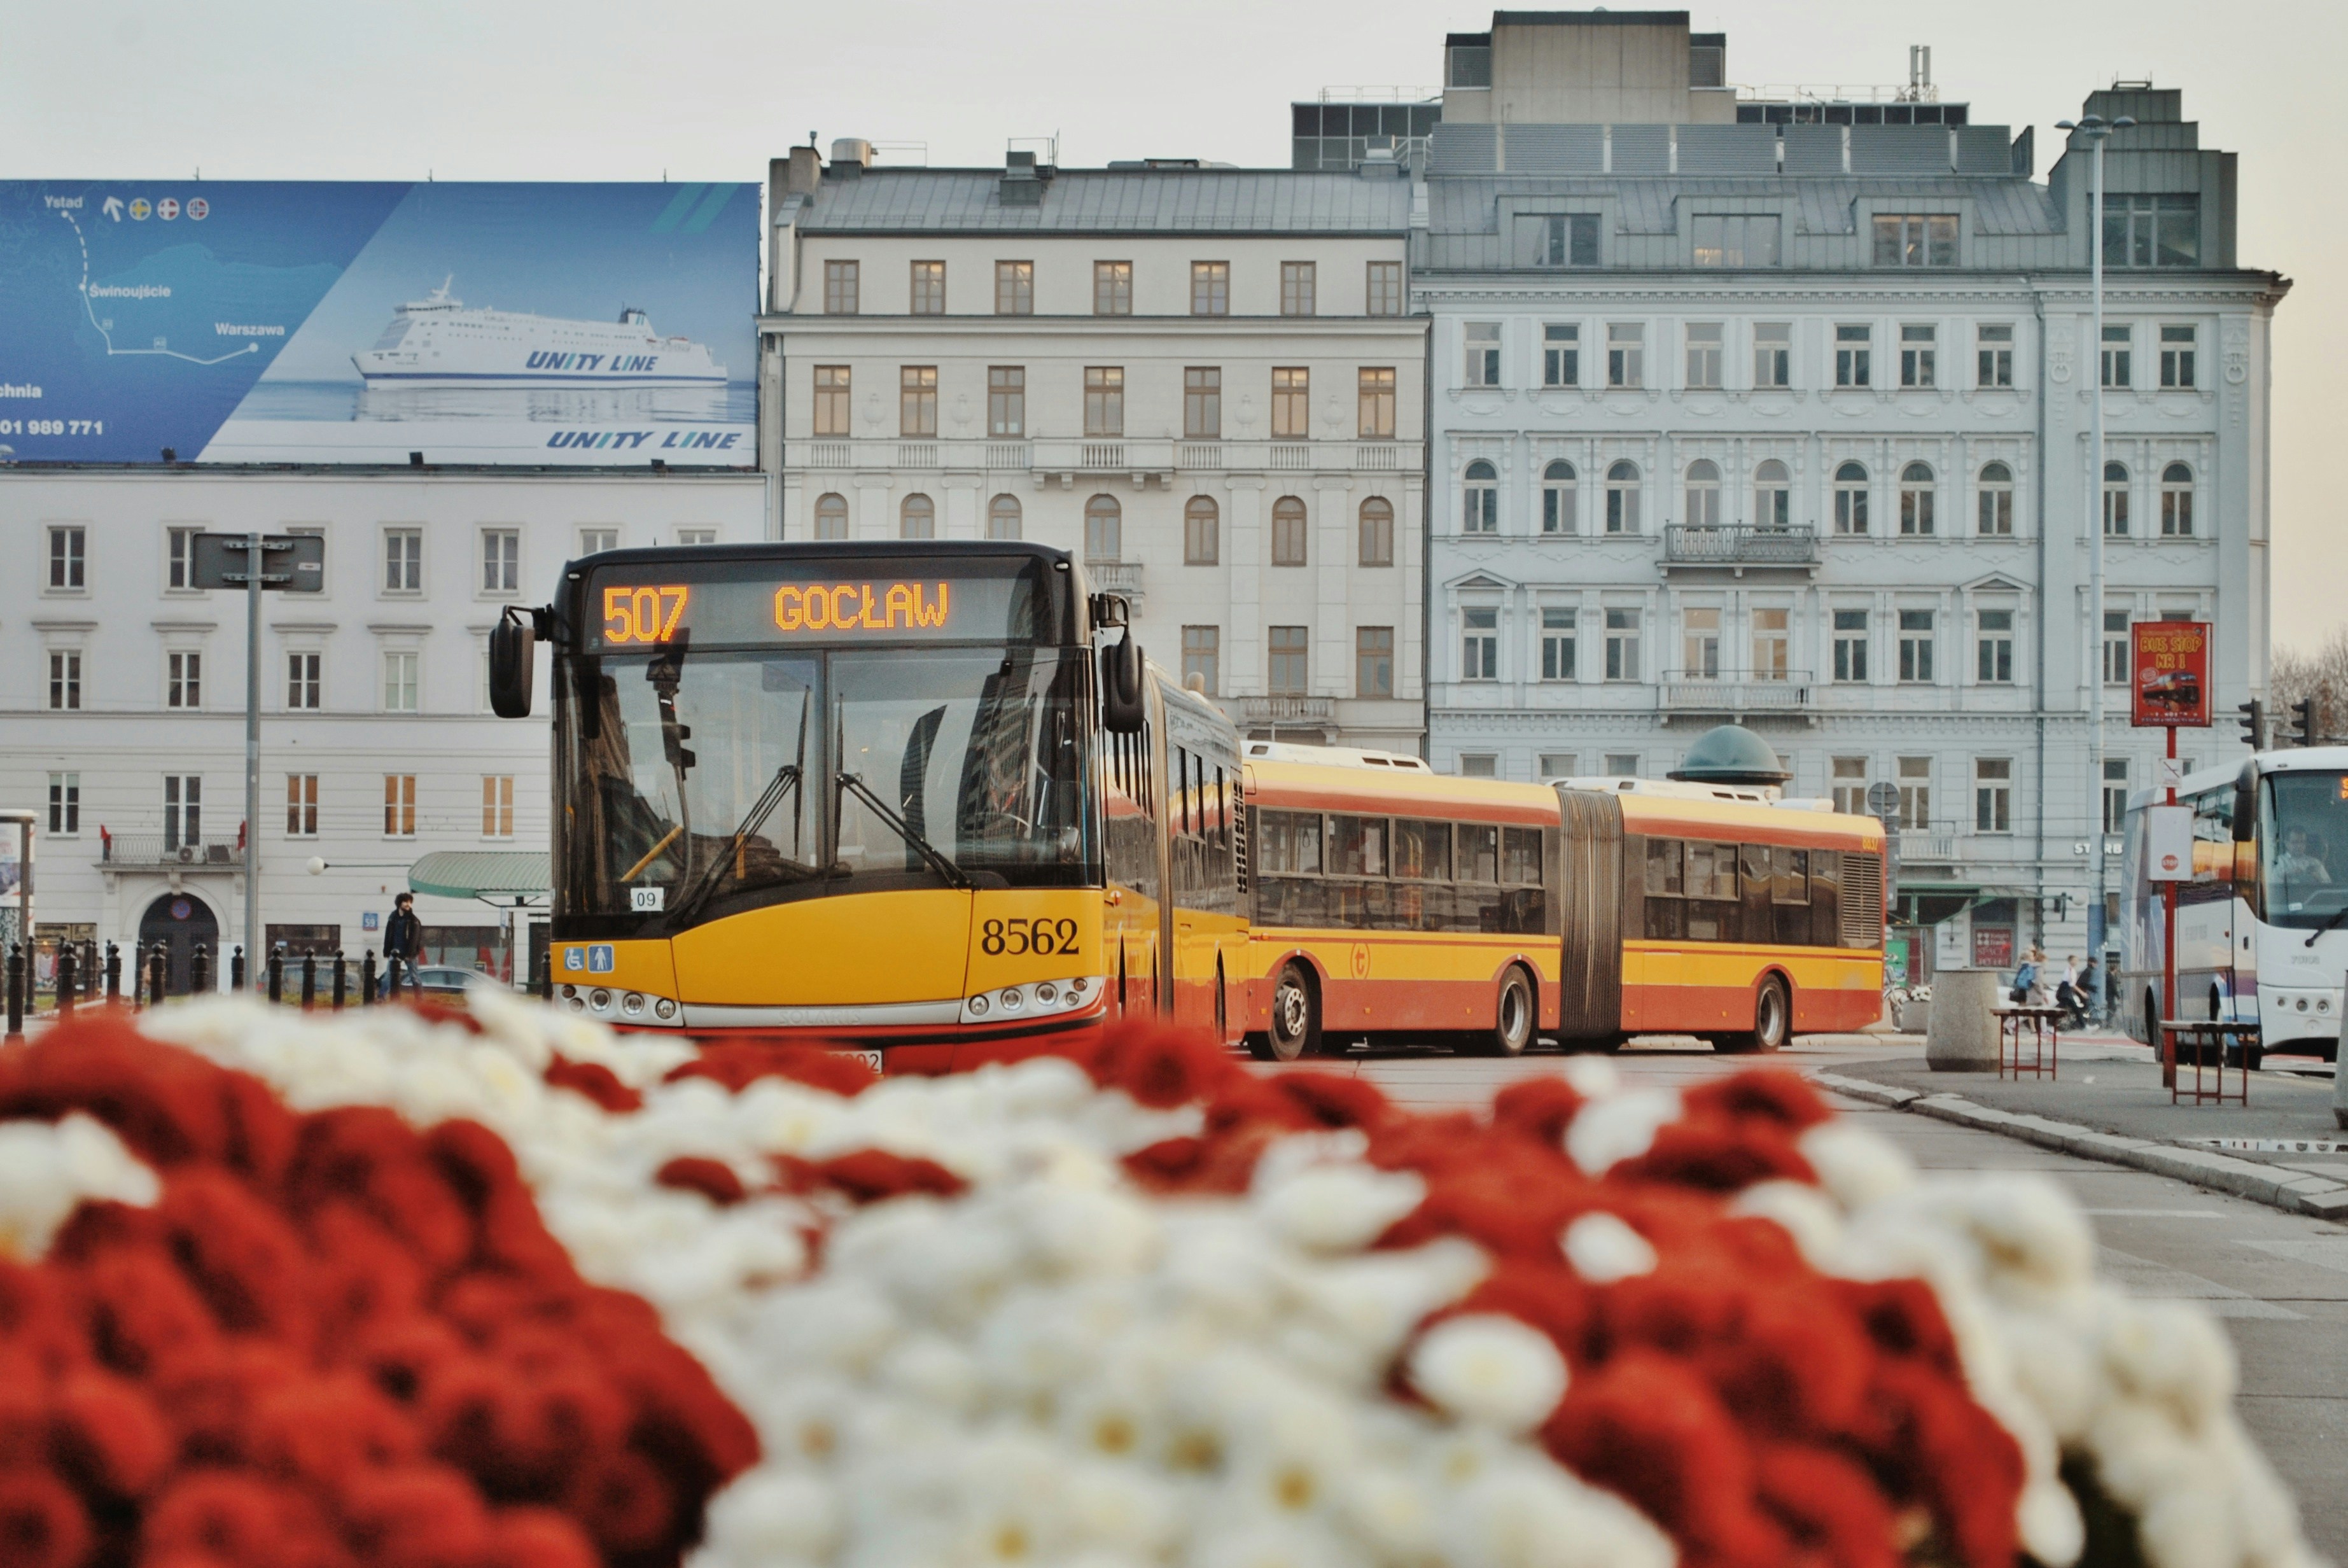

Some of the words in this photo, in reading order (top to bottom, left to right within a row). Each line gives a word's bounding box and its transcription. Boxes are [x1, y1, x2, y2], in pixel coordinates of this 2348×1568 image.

[44, 195, 83, 209] Ystad
[89, 282, 171, 300] Świnoujście
[214, 322, 285, 336] Warszawa
[526, 351, 604, 370] UNITY
[609, 355, 658, 371] LINE
[27, 420, 64, 435] 989
[68, 420, 102, 435] 771
[547, 431, 655, 449] UNITY
[660, 432, 742, 449] LINE
[604, 585, 688, 643] 507
[774, 582, 948, 631] GOCŁAW
[2140, 637, 2168, 653] BUS
[2170, 636, 2202, 653] STOP
[2156, 654, 2175, 669] NR
[2074, 843, 2123, 854] STRB
[637, 892, 655, 907] 09
[982, 918, 1080, 955] 8562
[779, 1009, 860, 1025] SOLARIS
